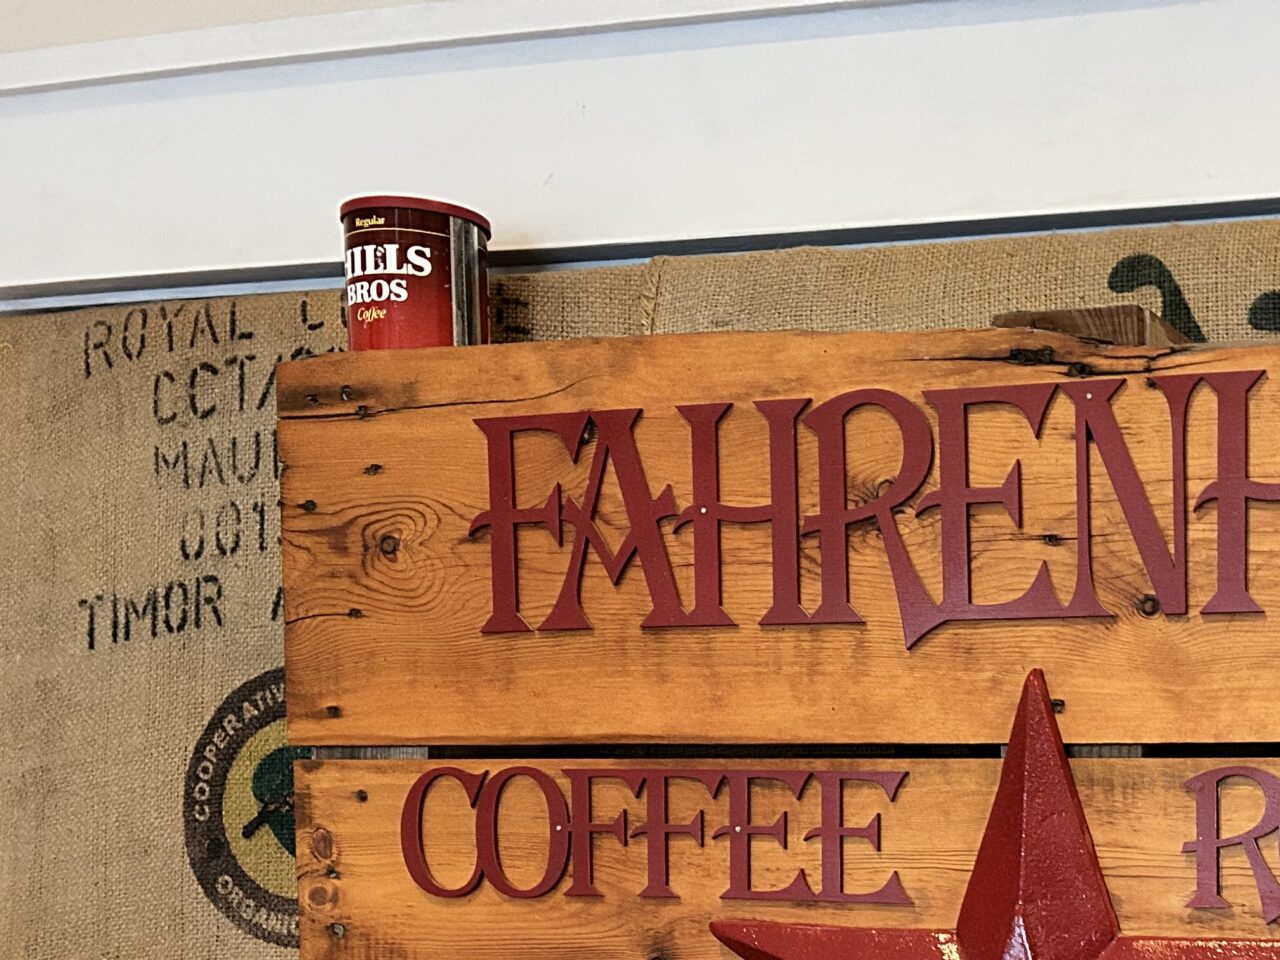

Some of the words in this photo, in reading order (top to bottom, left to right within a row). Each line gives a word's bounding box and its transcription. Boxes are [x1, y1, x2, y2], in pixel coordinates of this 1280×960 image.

[355, 215, 385, 227] Regular
[347, 279, 408, 306] BROS
[357, 306, 386, 322] Coffee
[84, 302, 255, 379] ROYAL
[78, 574, 224, 650] TIMOR
[400, 766, 914, 905] COFFEE
